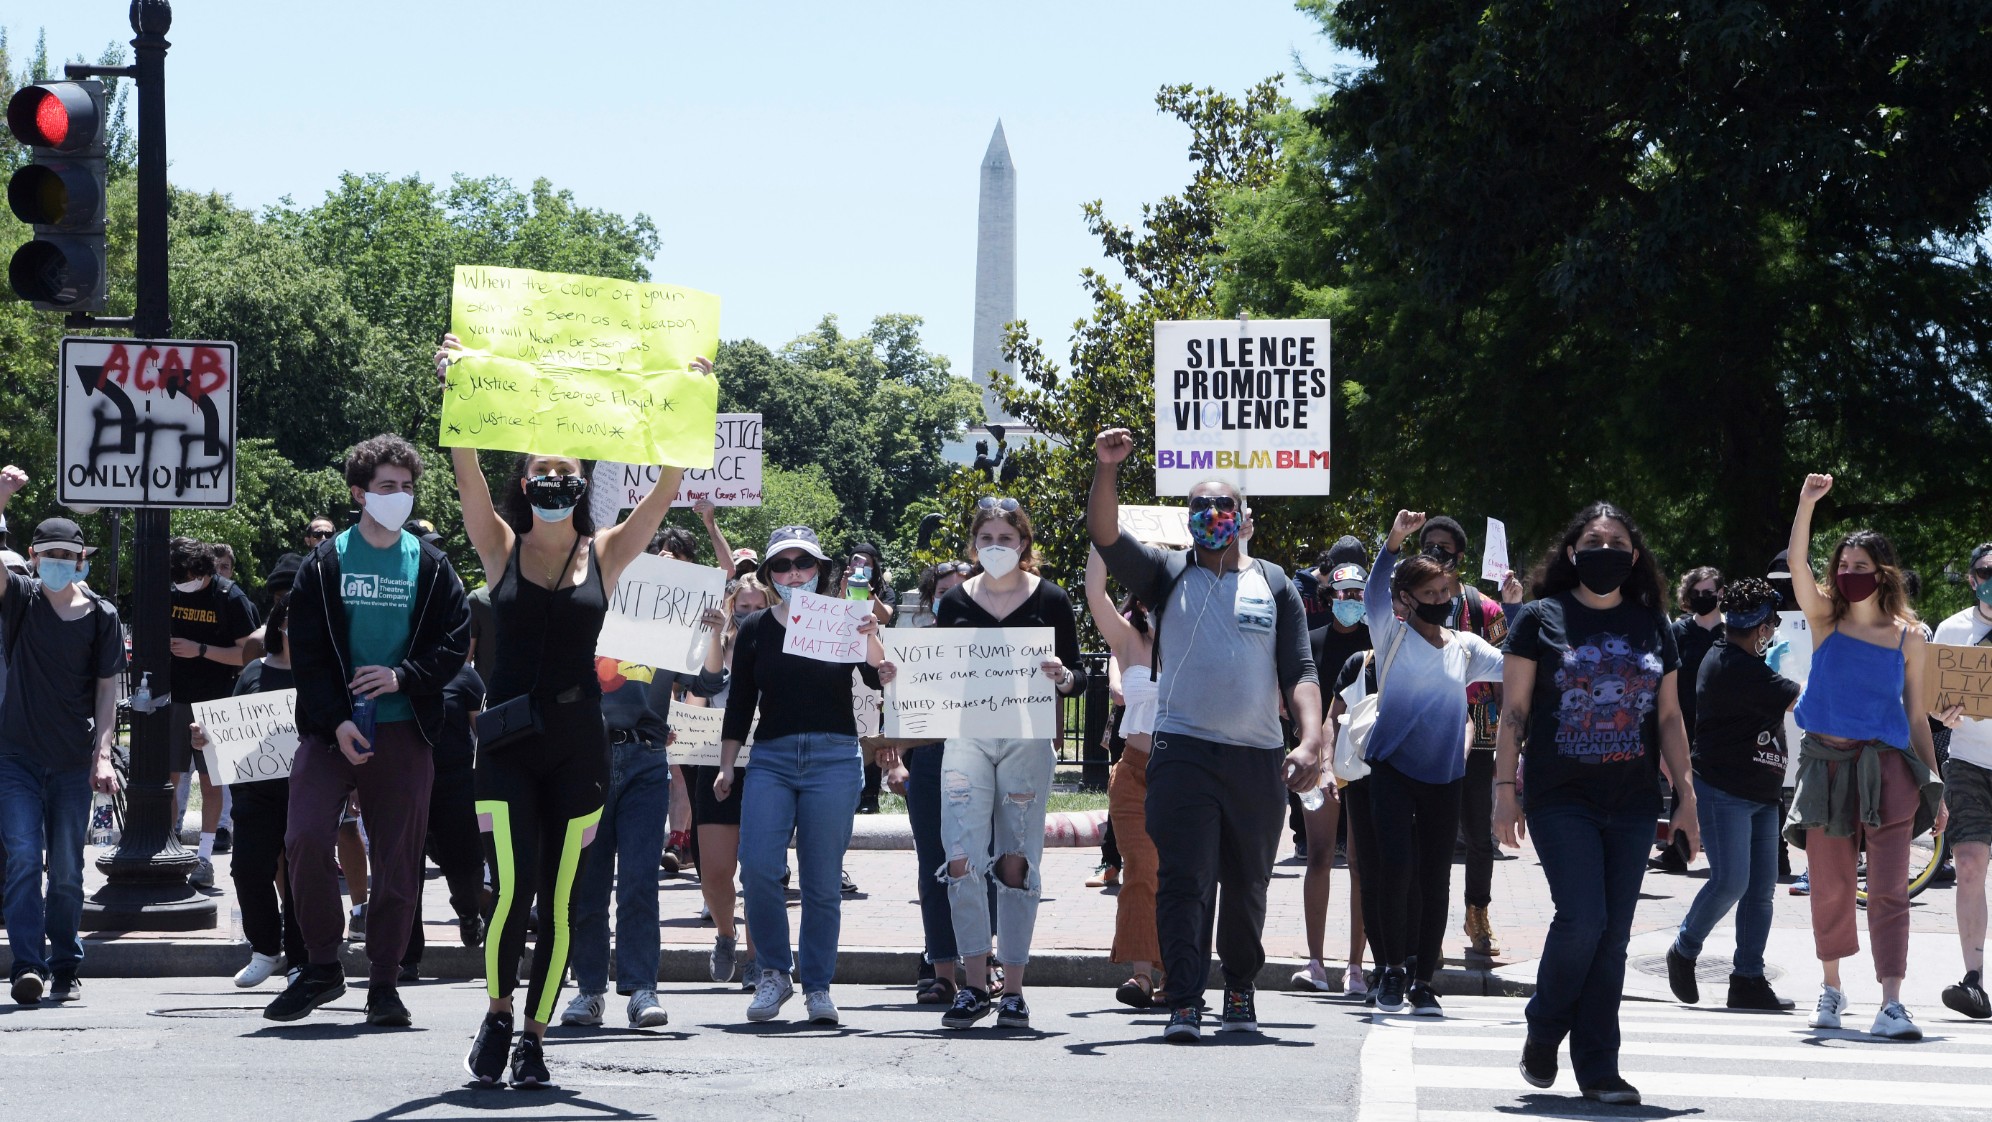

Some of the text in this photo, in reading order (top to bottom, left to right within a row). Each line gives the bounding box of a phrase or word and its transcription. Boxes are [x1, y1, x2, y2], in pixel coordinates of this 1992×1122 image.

[462, 268, 685, 309] When the color of your
[592, 315, 610, 327] as
[621, 318, 633, 329] a
[569, 333, 584, 348] be
[630, 341, 651, 352] as
[1186, 336, 1315, 369] SILENCE
[96, 342, 228, 398] ACAB
[1173, 368, 1326, 400] PROMOTES
[548, 385, 602, 407] George
[611, 389, 655, 418] Floyd
[1173, 399, 1309, 430] VIOLENCE
[1157, 449, 1330, 469] BLM BLM BLM
[68, 463, 225, 490] ONLY ONLY
[715, 487, 737, 501] George
[379, 585, 405, 594] Theatre
[380, 577, 416, 588] Educational
[378, 592, 410, 602] Company
[800, 595, 860, 621] BLACK
[805, 617, 854, 637] LIVES
[790, 635, 863, 658] MATTER
[893, 644, 945, 663] VOTE
[953, 644, 1017, 659] TRUMP
[1937, 648, 1992, 672] BLA
[910, 671, 943, 685] SAVE
[950, 670, 979, 680] OUR
[199, 706, 230, 726] the
[237, 701, 281, 722] time
[892, 695, 1053, 712] UNITED States of America
[212, 721, 264, 745] social
[1757, 750, 1781, 763] YES
